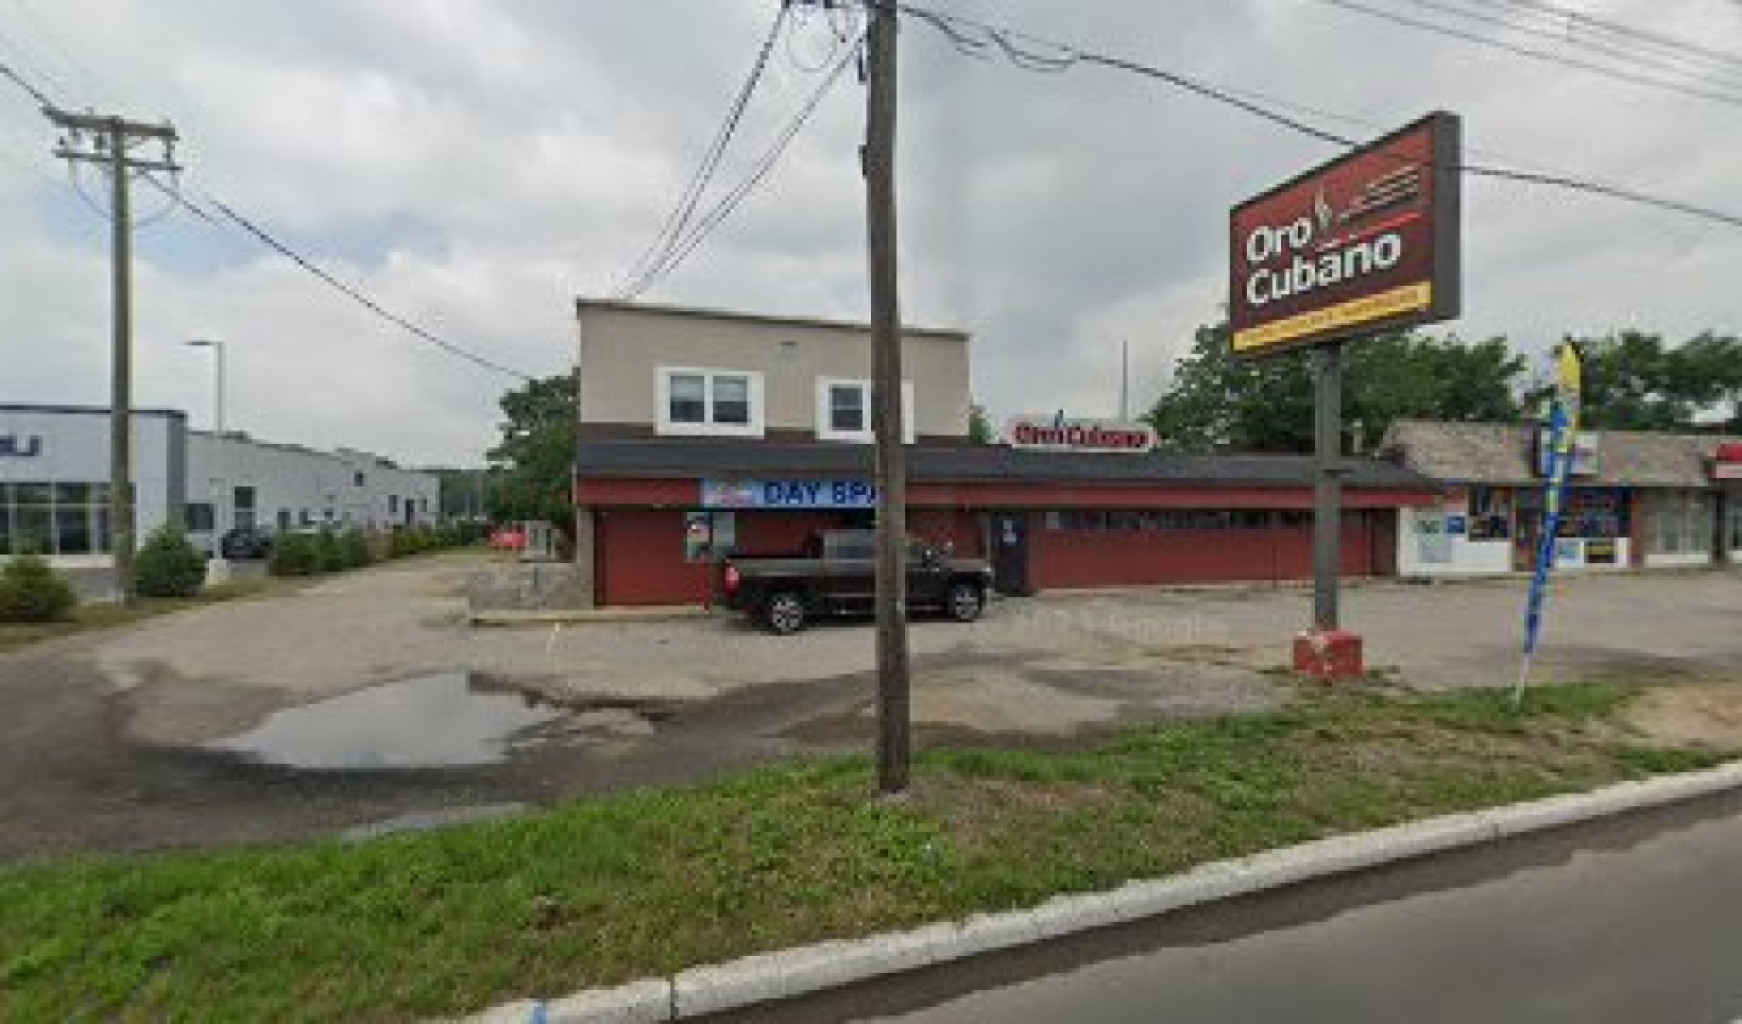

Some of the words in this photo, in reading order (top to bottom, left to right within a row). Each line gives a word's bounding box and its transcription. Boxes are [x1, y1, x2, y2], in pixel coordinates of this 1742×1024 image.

[1247, 218, 1312, 261] Oro
[1247, 233, 1401, 304] Cubano
[764, 481, 821, 505] DAY
